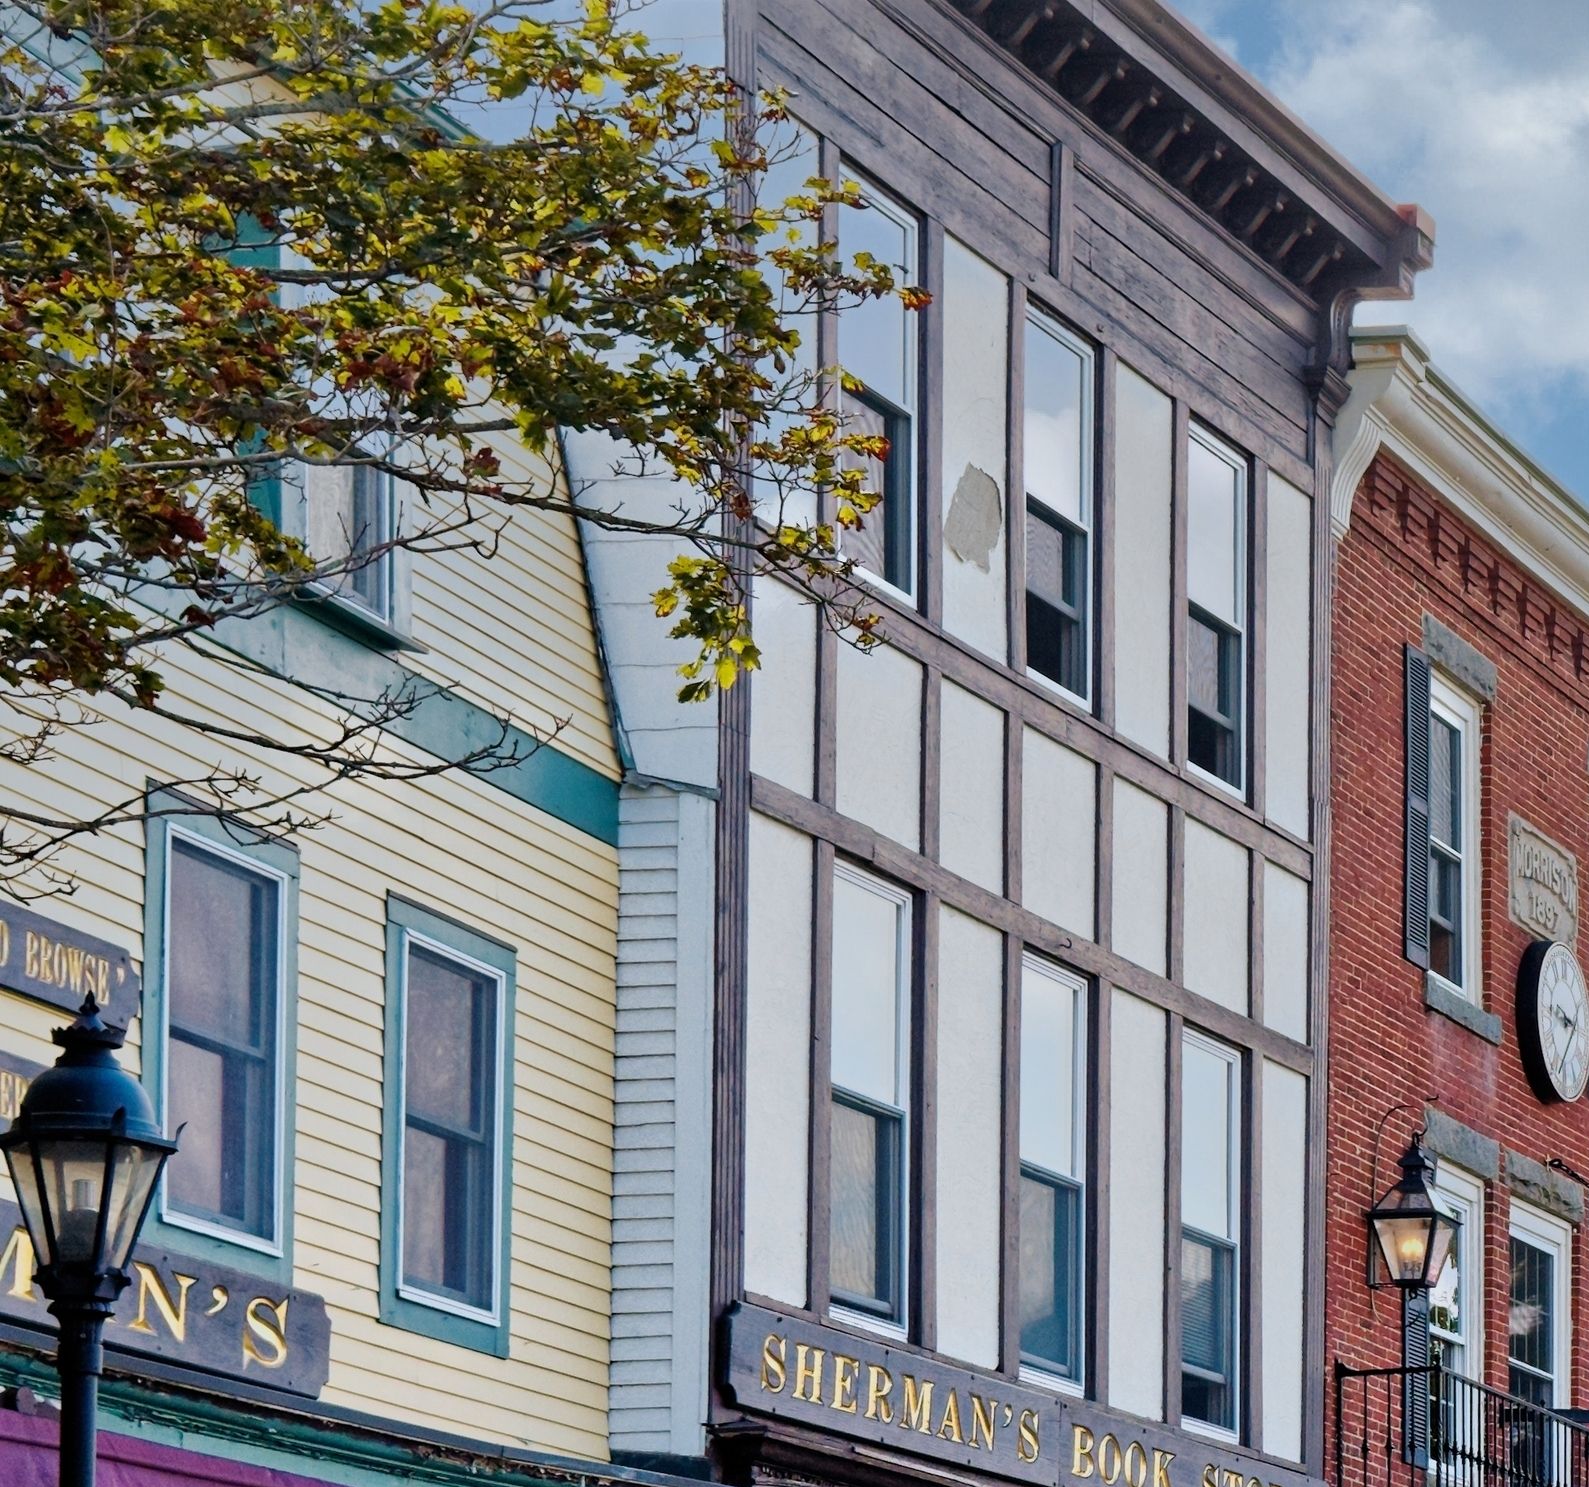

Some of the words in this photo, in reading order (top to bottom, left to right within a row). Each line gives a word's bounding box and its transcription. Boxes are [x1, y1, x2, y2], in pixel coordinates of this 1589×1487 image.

[1516, 839, 1577, 911] MORRISON
[1530, 893, 1559, 934] 1897
[760, 1333, 1040, 1463] SHERMAN'S
